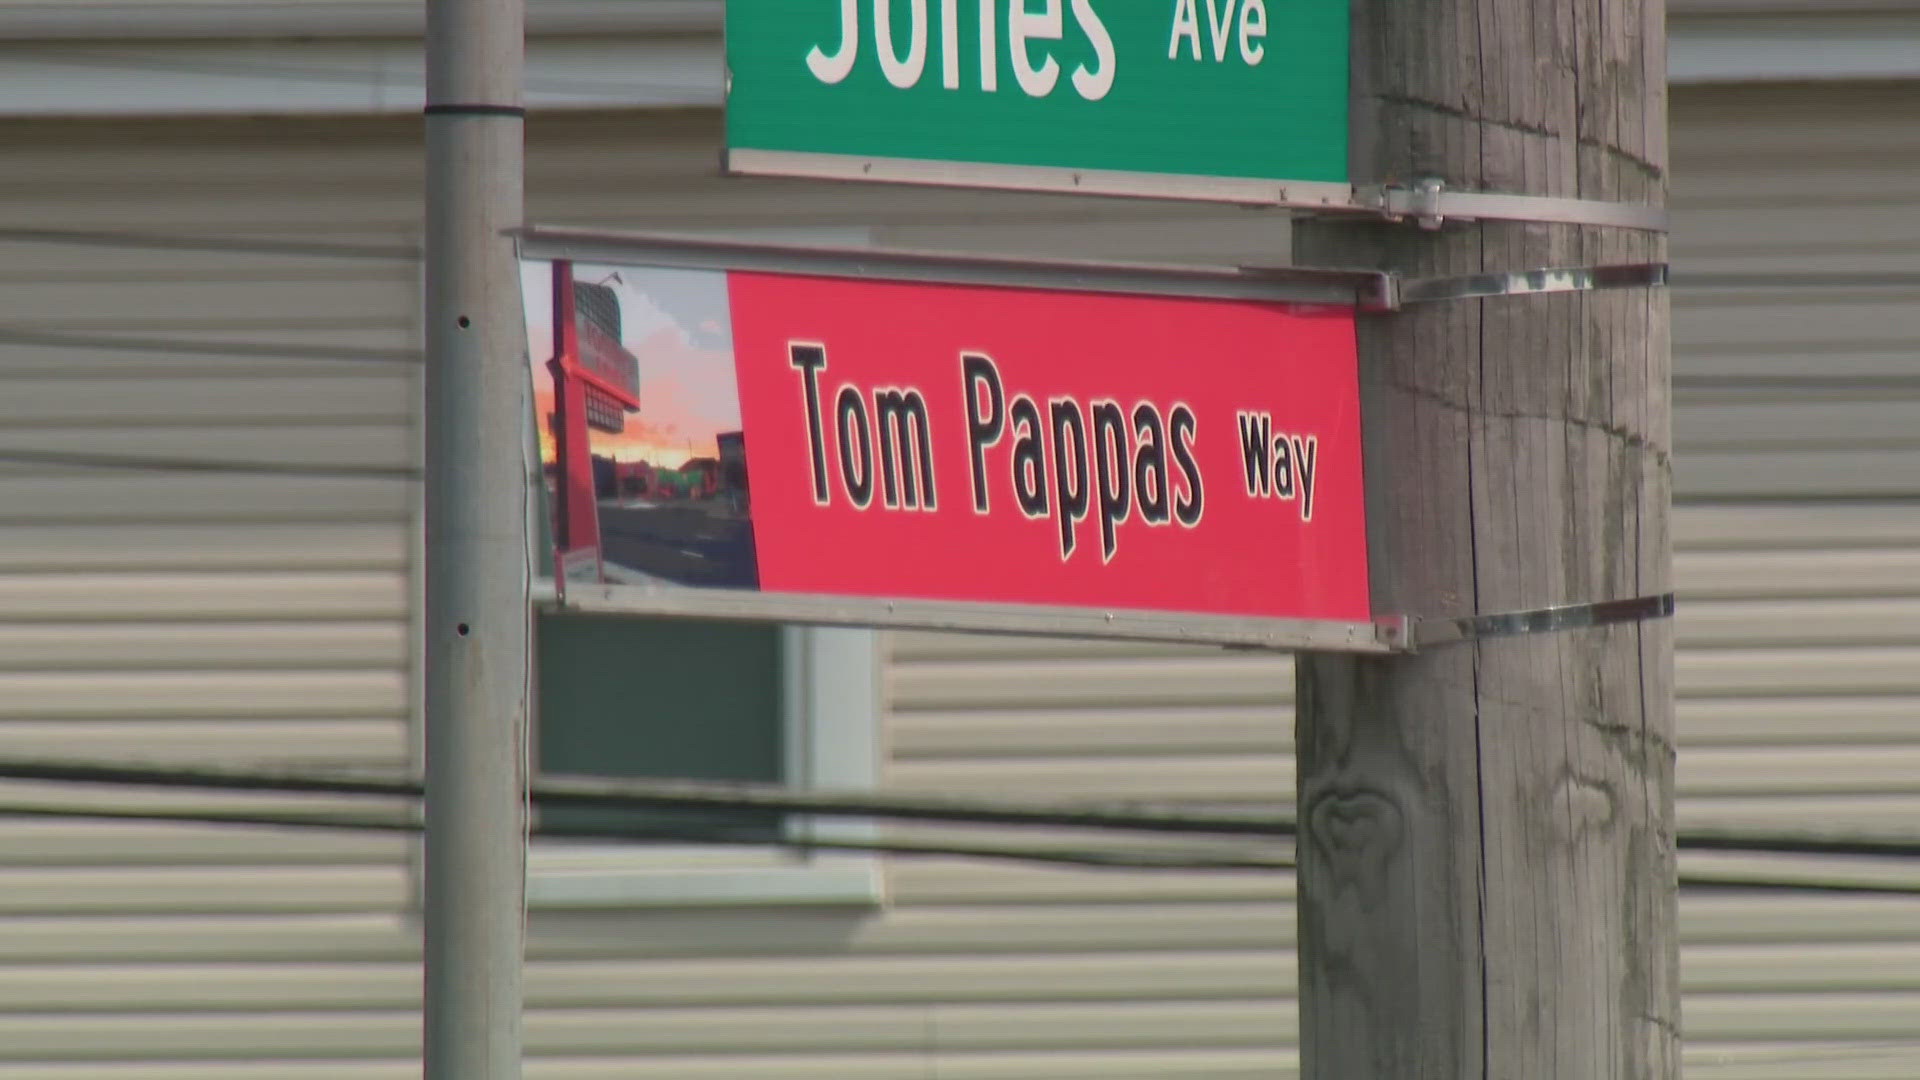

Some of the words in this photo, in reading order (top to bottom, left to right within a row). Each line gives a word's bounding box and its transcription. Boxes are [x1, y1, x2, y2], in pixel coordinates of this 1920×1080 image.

[1168, 0, 1268, 66] Ave
[787, 340, 938, 513] Tom
[960, 350, 1204, 566] Pappas
[1237, 410, 1317, 522] Way
